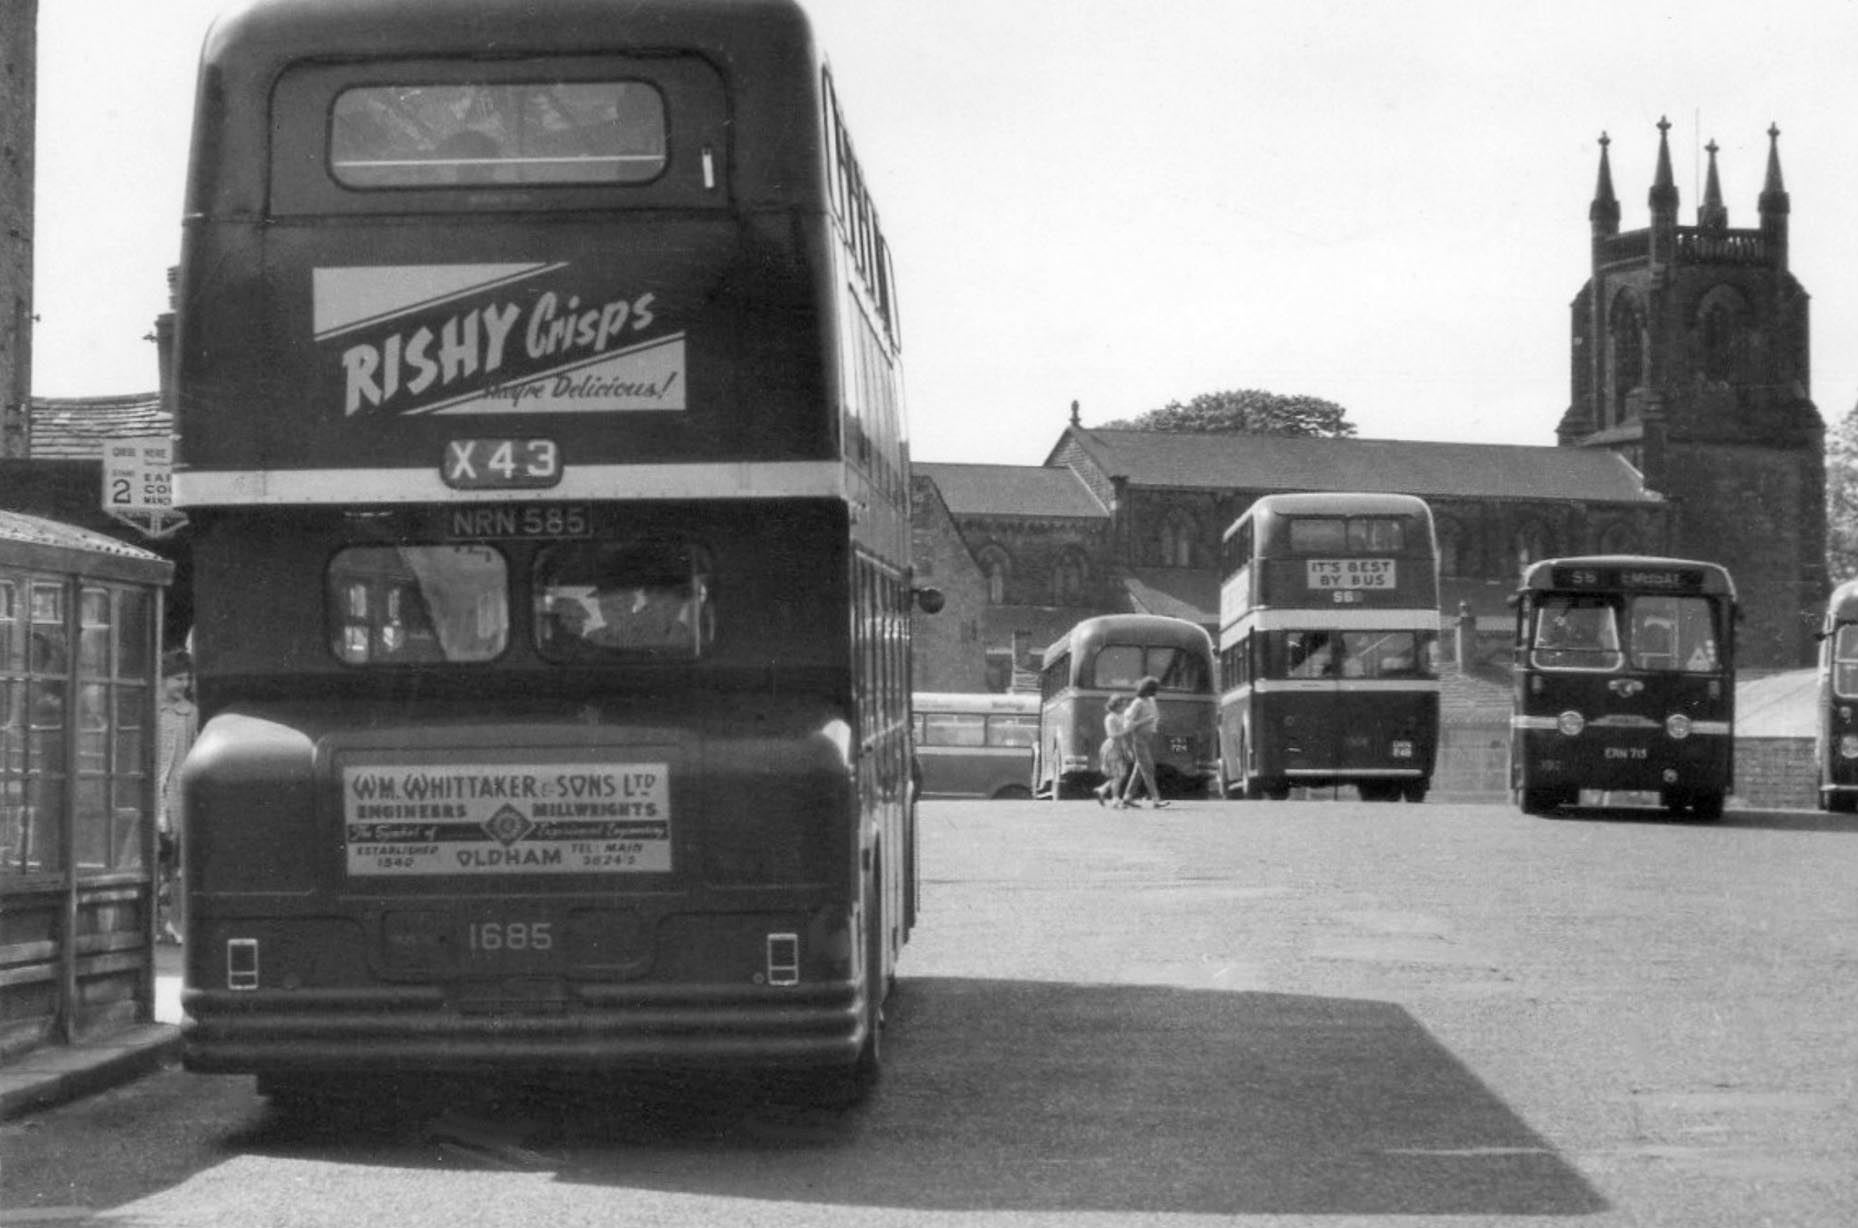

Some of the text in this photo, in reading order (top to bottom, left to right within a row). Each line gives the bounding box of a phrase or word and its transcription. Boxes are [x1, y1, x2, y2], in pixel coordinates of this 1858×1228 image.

[342, 291, 655, 417] RISHY Crisps
[552, 371, 677, 399] Delicious!
[112, 479, 132, 504] 2
[453, 507, 586, 535] NRN 585
[1320, 574, 1385, 586] BY BUS
[1347, 561, 1391, 573] BEST
[402, 773, 537, 801] WHITTAKER
[556, 773, 616, 798] SONS
[623, 773, 656, 797] LTD
[356, 802, 657, 819] ENGINEERS MILLWRIGHTS
[457, 848, 562, 867] OLDHAM
[469, 922, 552, 951] 1685
